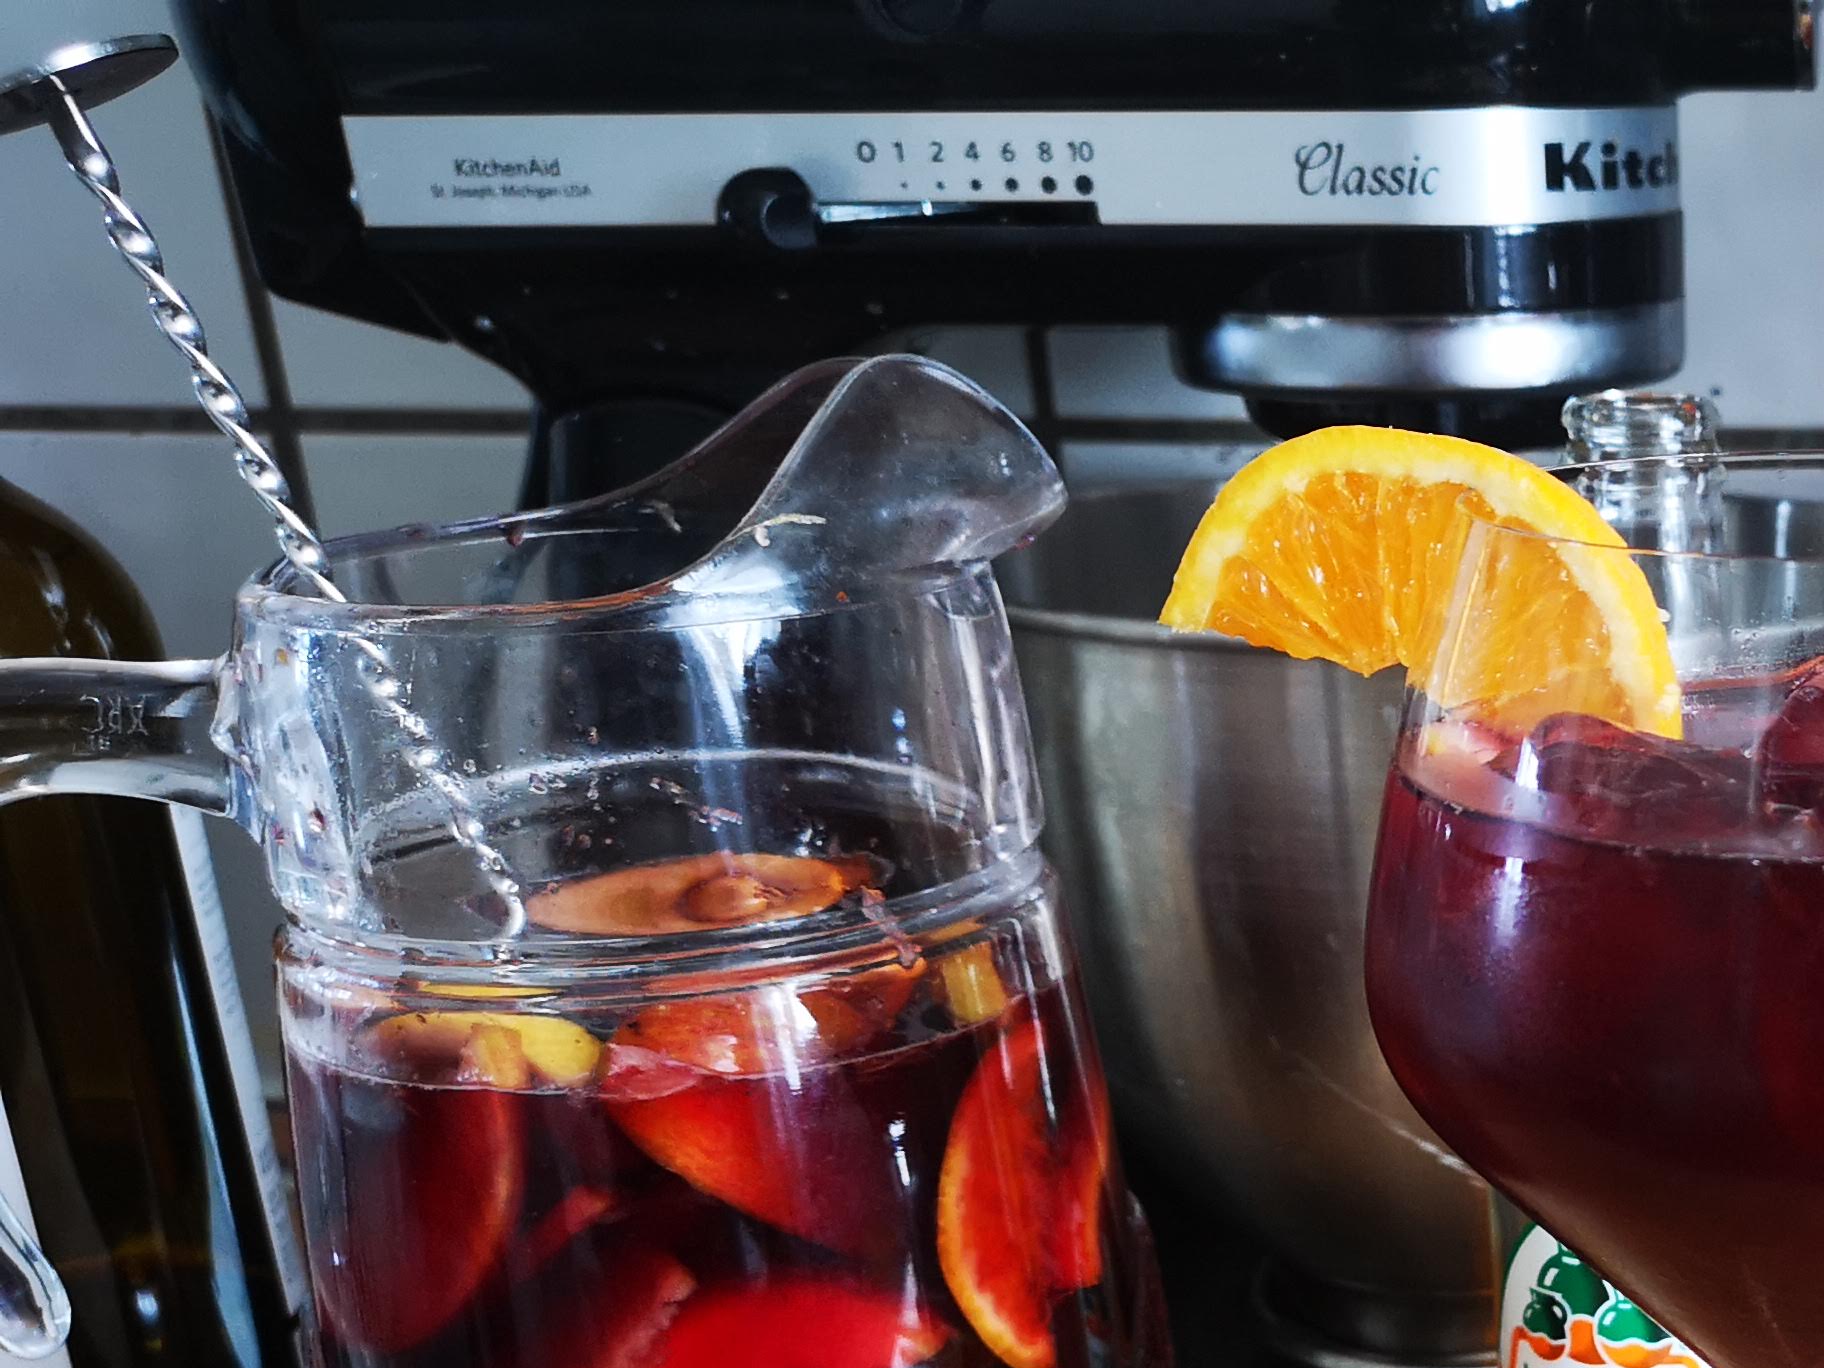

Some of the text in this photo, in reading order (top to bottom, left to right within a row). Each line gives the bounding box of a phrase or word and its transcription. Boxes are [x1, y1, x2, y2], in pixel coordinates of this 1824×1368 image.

[856, 140, 1095, 164] 0 1 2 4 6 8 10
[453, 156, 562, 177] KitchenAid
[1294, 140, 1441, 197] Classic
